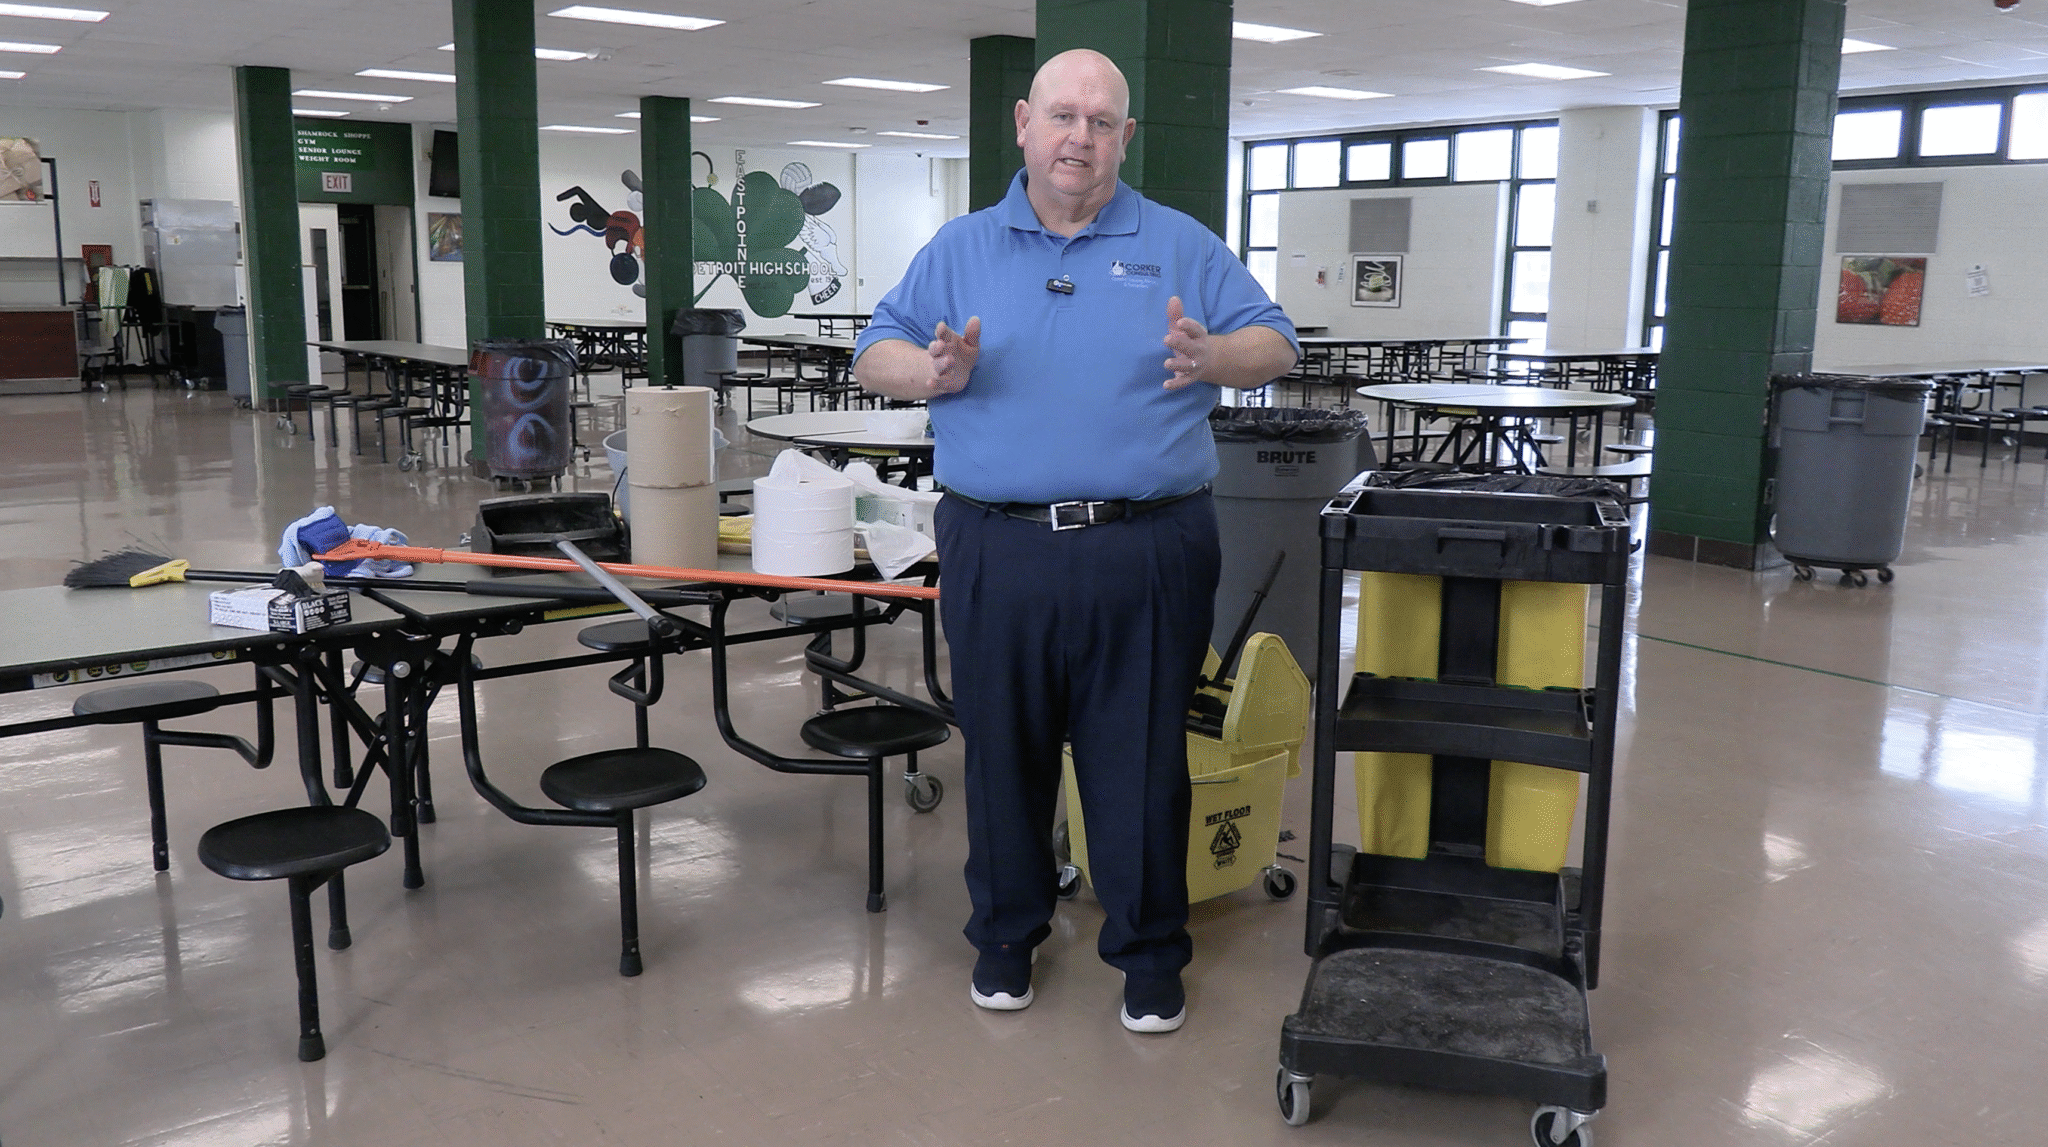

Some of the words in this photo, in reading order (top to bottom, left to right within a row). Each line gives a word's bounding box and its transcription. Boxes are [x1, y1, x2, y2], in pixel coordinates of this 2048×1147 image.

[297, 130, 338, 138] SHAMROCK
[298, 146, 328, 154] SENIOR
[331, 147, 362, 156] LOUNGE
[326, 175, 348, 190] EXIT
[735, 149, 747, 289] EASTPOINTE
[749, 261, 784, 275] HIGH
[785, 261, 837, 275] SCHOOL
[1125, 263, 1161, 272] CORKER
[814, 282, 839, 304] CHEER
[1257, 451, 1316, 464] BRUTE
[301, 599, 325, 610] BLACK
[1205, 811, 1223, 824] WET
[1225, 805, 1251, 820] FLOOR
